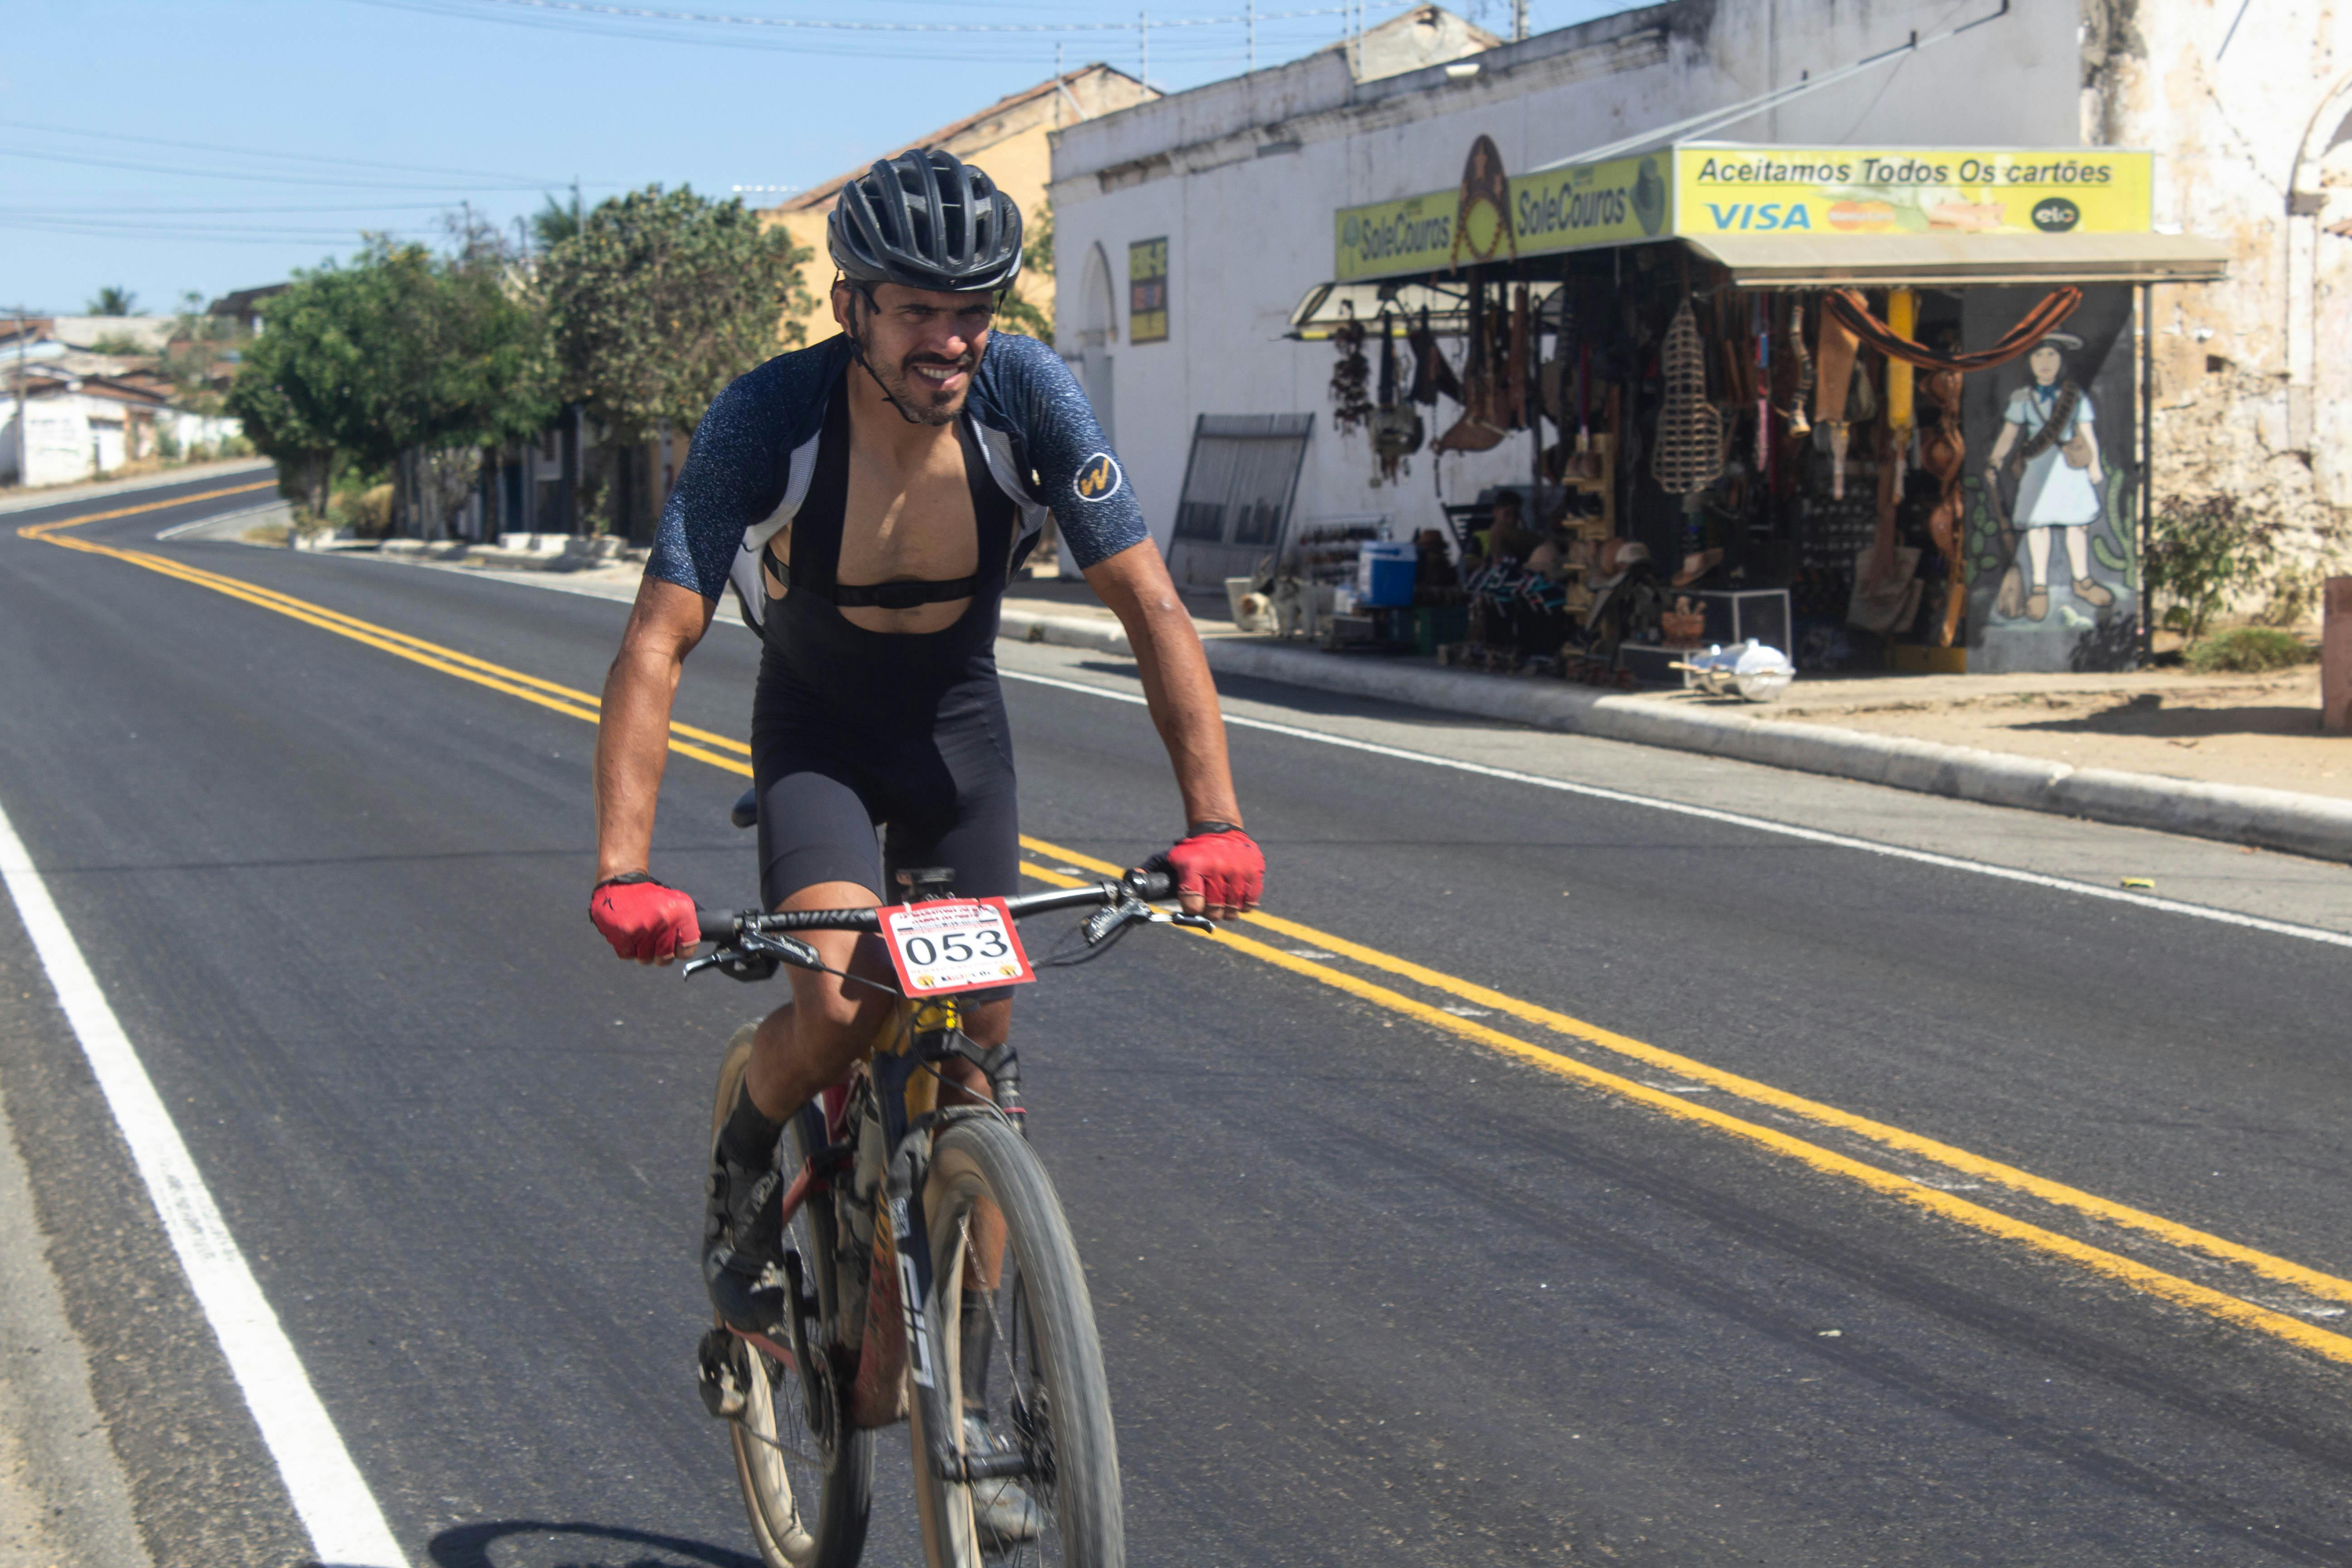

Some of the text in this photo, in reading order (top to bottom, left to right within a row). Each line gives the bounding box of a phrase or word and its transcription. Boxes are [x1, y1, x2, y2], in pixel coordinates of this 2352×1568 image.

[1697, 157, 2112, 182] Aceitamos Todos Os cartões
[1702, 203, 1811, 230] VISA
[906, 930, 1008, 965] 053
